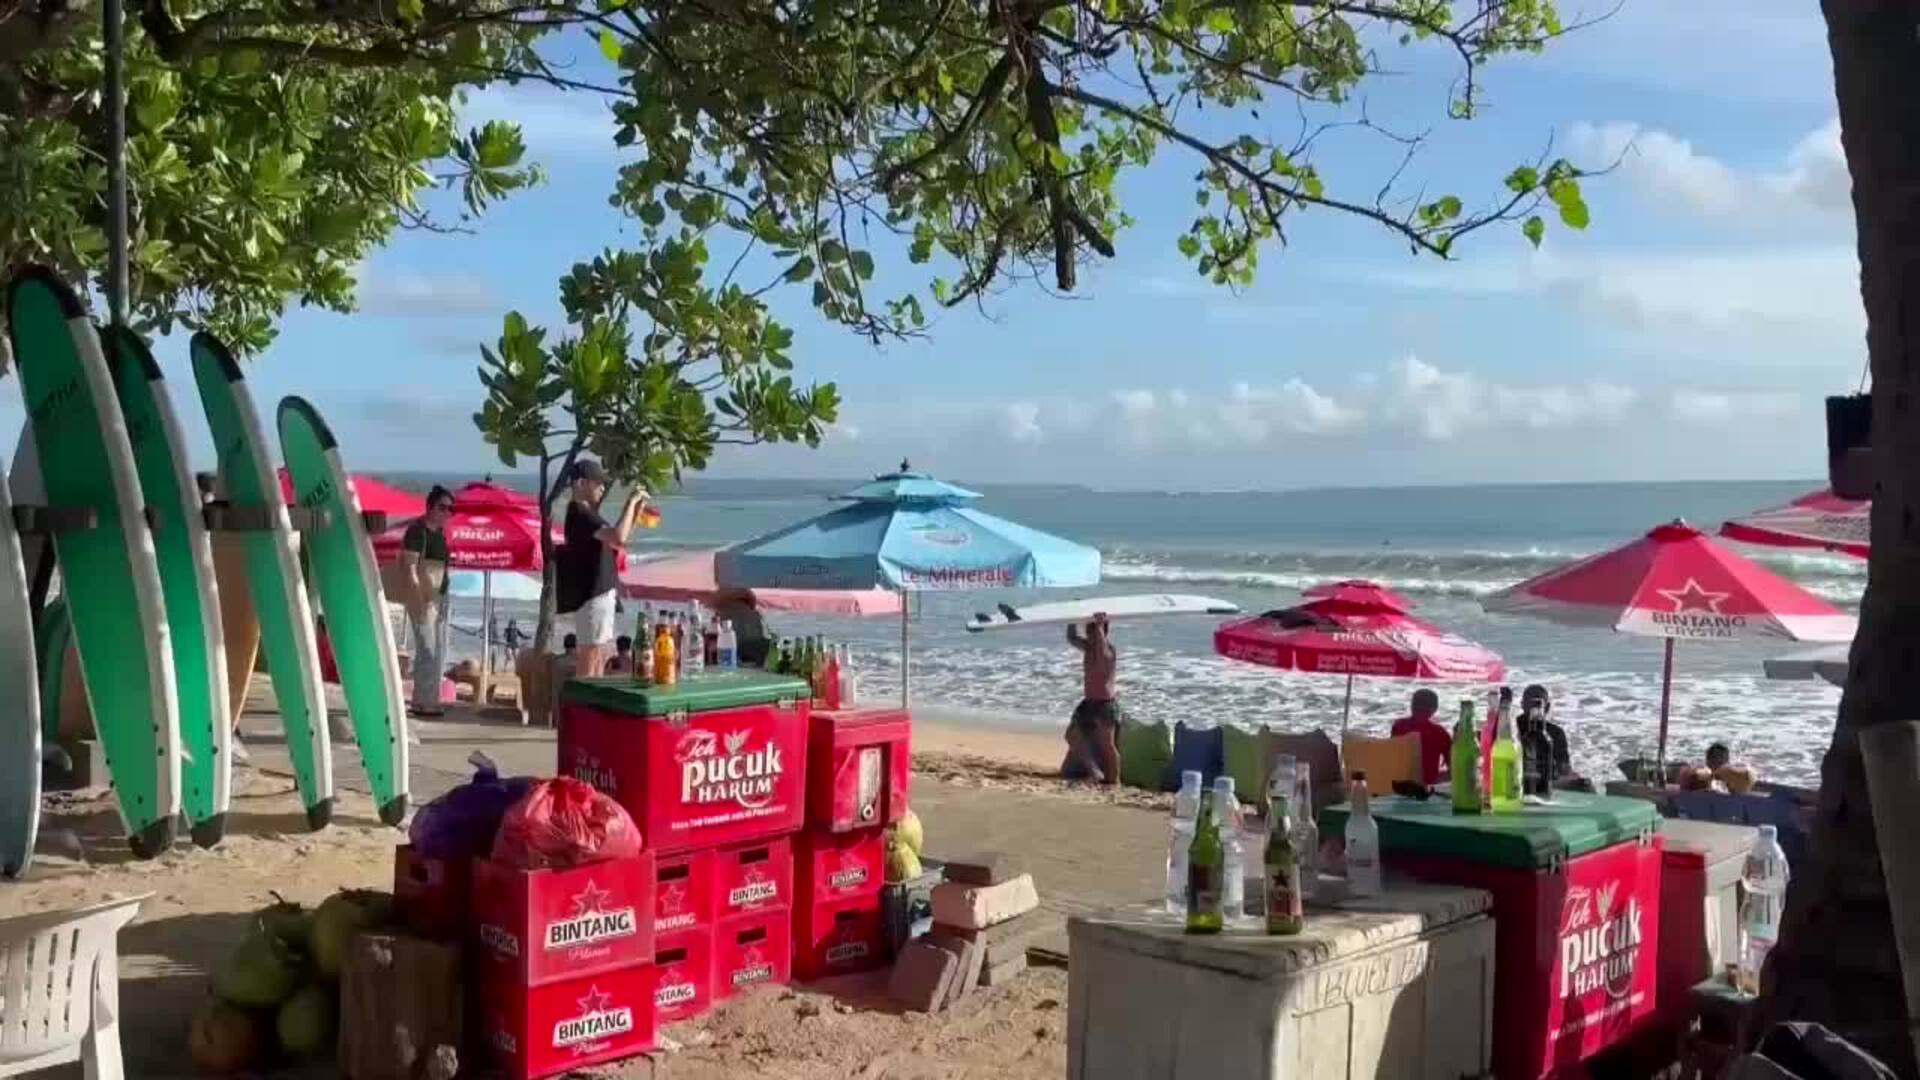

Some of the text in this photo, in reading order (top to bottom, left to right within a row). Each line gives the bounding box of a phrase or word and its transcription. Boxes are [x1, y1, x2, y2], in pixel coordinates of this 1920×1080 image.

[900, 565, 1014, 584] Le Minerale
[1652, 611, 1746, 628] BINTANG
[1664, 626, 1737, 638] CRYSTAL
[698, 777, 771, 807] HARUM
[829, 868, 866, 888] BINTANG
[732, 883, 774, 902] BINTANG
[551, 912, 631, 943] BINTANG
[655, 912, 696, 932] INTANG
[731, 966, 772, 984] BINTANG
[1575, 952, 1634, 997] HARUM
[656, 985, 693, 1002] NTANG
[558, 1011, 628, 1040] BINTANG
